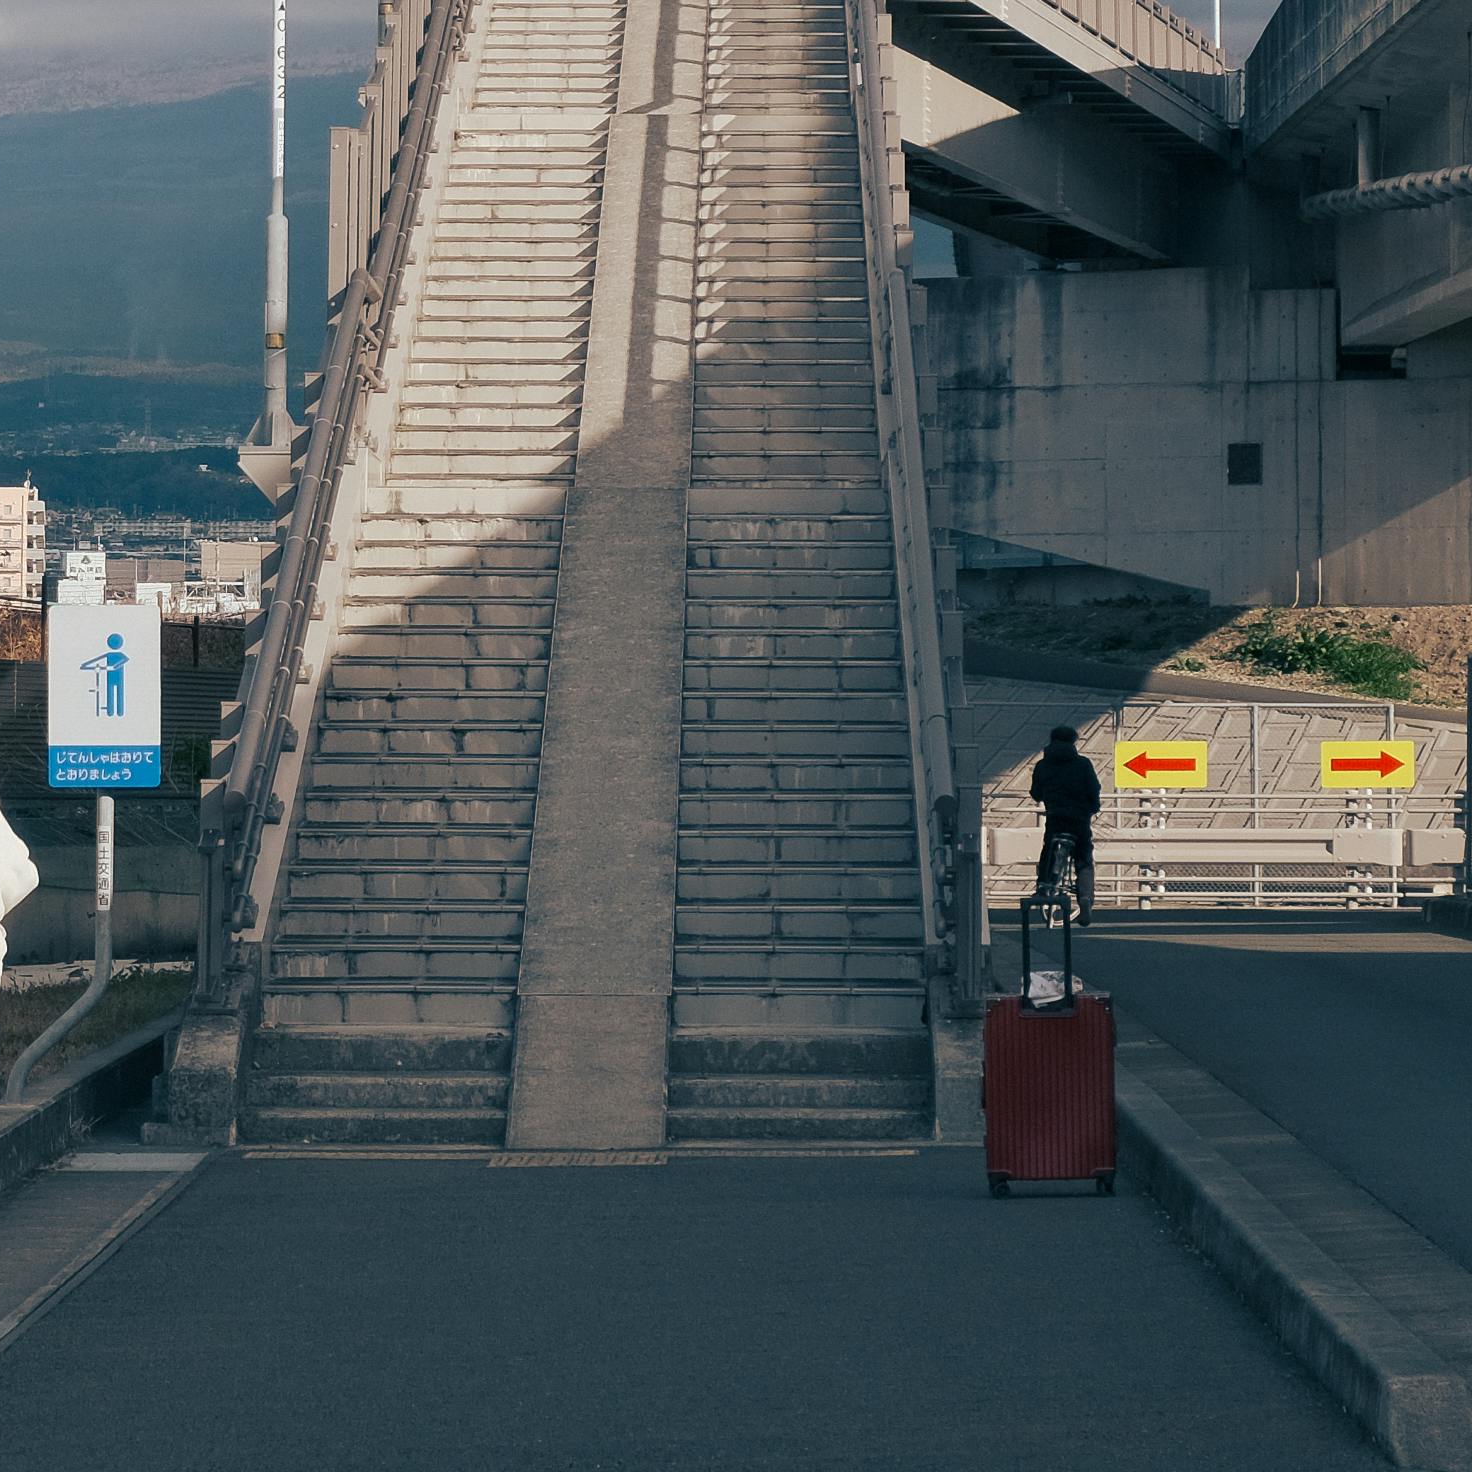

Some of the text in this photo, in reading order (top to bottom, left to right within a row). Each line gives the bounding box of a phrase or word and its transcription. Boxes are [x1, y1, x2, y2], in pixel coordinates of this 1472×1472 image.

[55, 751, 154, 763] じてんしゃはおりて
[55, 768, 132, 781] とおりましょう
